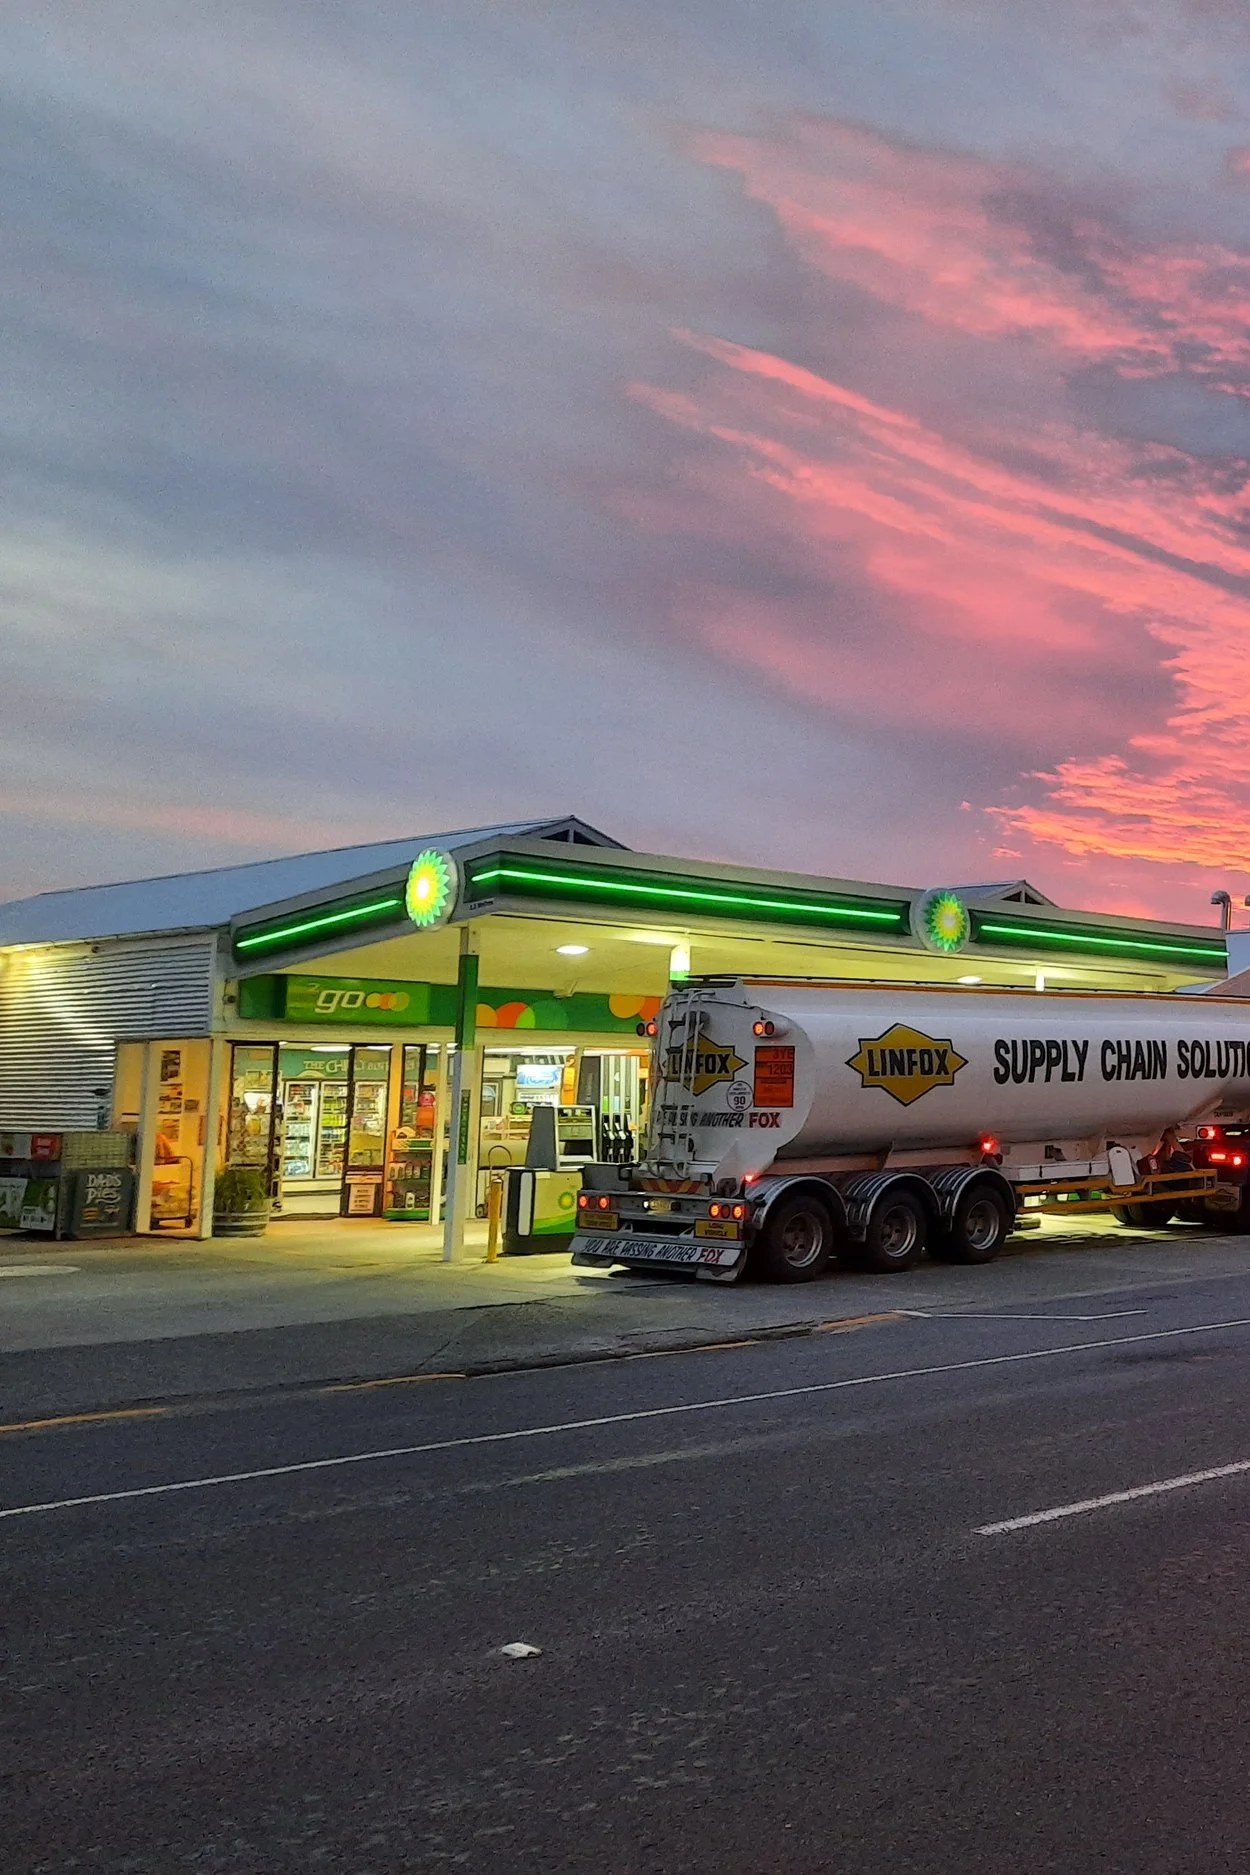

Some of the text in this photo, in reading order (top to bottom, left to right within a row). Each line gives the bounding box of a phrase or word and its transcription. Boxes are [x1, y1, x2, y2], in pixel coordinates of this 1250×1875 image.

[772, 1048, 793, 1060] 3YE
[304, 1060, 325, 1070] THE
[768, 1063, 793, 1075] 1203
[867, 1048, 950, 1077] LINFOX
[993, 1039, 1089, 1085] SUPPLY
[1100, 1039, 1167, 1082] CHAIN
[733, 1096, 746, 1106] 90
[700, 1111, 744, 1128] ANOTHER
[749, 1112, 780, 1128] FOX
[584, 1239, 725, 1264] YOU ARE PASSING ANOTHER FOX
